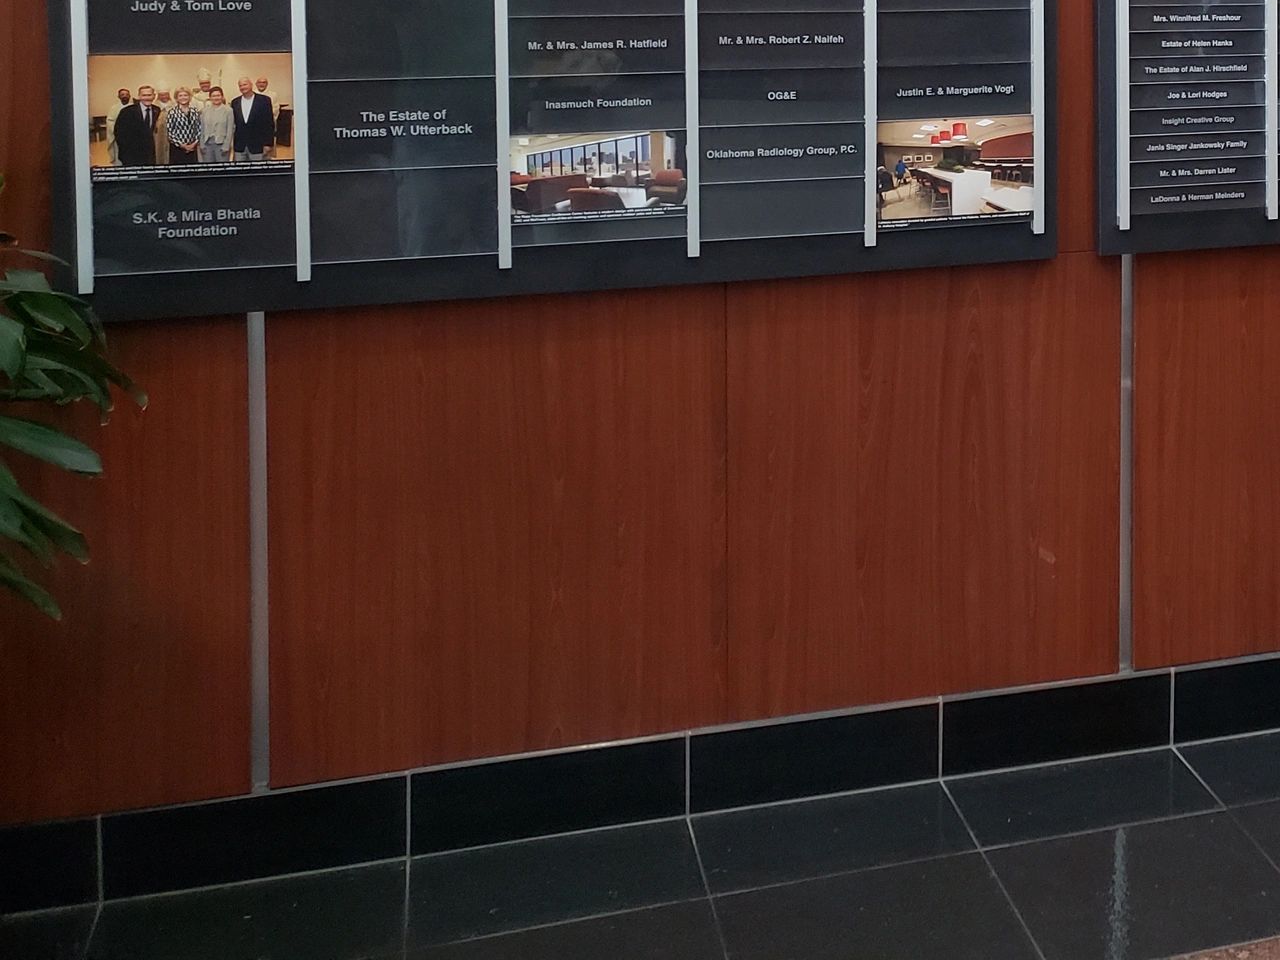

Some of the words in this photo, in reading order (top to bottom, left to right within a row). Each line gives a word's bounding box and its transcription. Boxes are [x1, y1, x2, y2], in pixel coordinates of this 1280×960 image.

[130, 0, 166, 13] Judy
[170, 0, 180, 11] &
[183, 0, 213, 11] Tom
[218, 0, 251, 10] Love
[767, 91, 796, 100] OG&E
[545, 99, 594, 109] Inasmuch
[596, 97, 651, 107] Foundation
[359, 111, 385, 122] The
[389, 110, 429, 121] Estate
[433, 109, 446, 120] of
[333, 127, 387, 138] Thomas
[389, 125, 406, 136] W.
[410, 123, 472, 135] Utterback
[706, 149, 754, 158] Oklahoma
[757, 147, 804, 157] Radiology
[806, 146, 837, 155] Group,
[840, 144, 857, 153] P.C.
[132, 212, 162, 224] S.K.
[167, 211, 177, 222] &
[181, 210, 212, 221] Mira
[217, 208, 260, 220] Bhatia
[158, 225, 237, 238] Foundation
